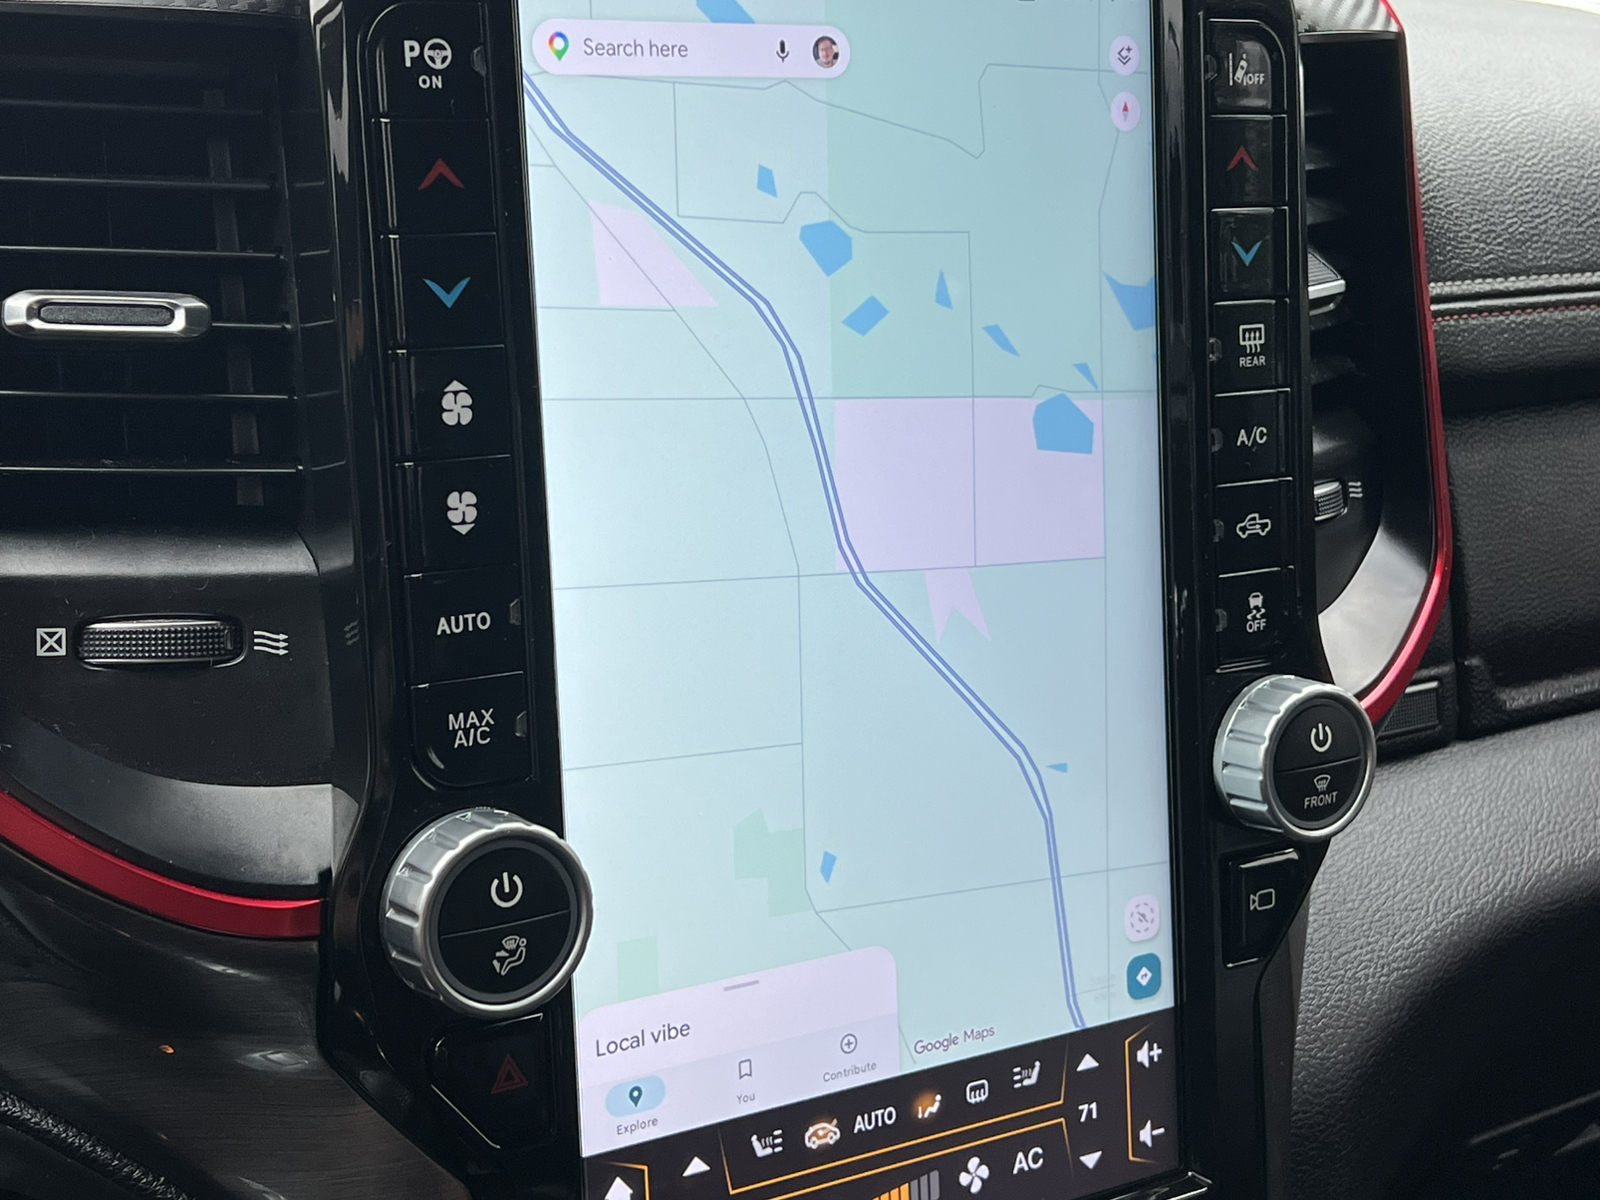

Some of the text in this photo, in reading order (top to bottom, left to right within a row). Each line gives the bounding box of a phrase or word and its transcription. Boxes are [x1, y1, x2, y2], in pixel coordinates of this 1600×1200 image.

[582, 38, 689, 59] Search here
[418, 75, 443, 90] ON
[1246, 73, 1266, 86] OFF
[1239, 355, 1267, 368] REAR
[1236, 426, 1268, 447] A/C
[436, 611, 491, 636] AUTO
[1246, 618, 1267, 633] OFF
[448, 708, 495, 731] MAX
[453, 726, 491, 749] A/C
[1303, 791, 1339, 810] FRONT
[595, 1020, 691, 1058] Local vibe
[913, 1025, 996, 1056] Google Maps
[822, 1060, 878, 1083] Contribute
[735, 1091, 756, 1105] You
[853, 1105, 897, 1134] AUTO
[1077, 1101, 1098, 1123] 71
[616, 1115, 659, 1136] Explore
[1012, 1146, 1044, 1175] AC
